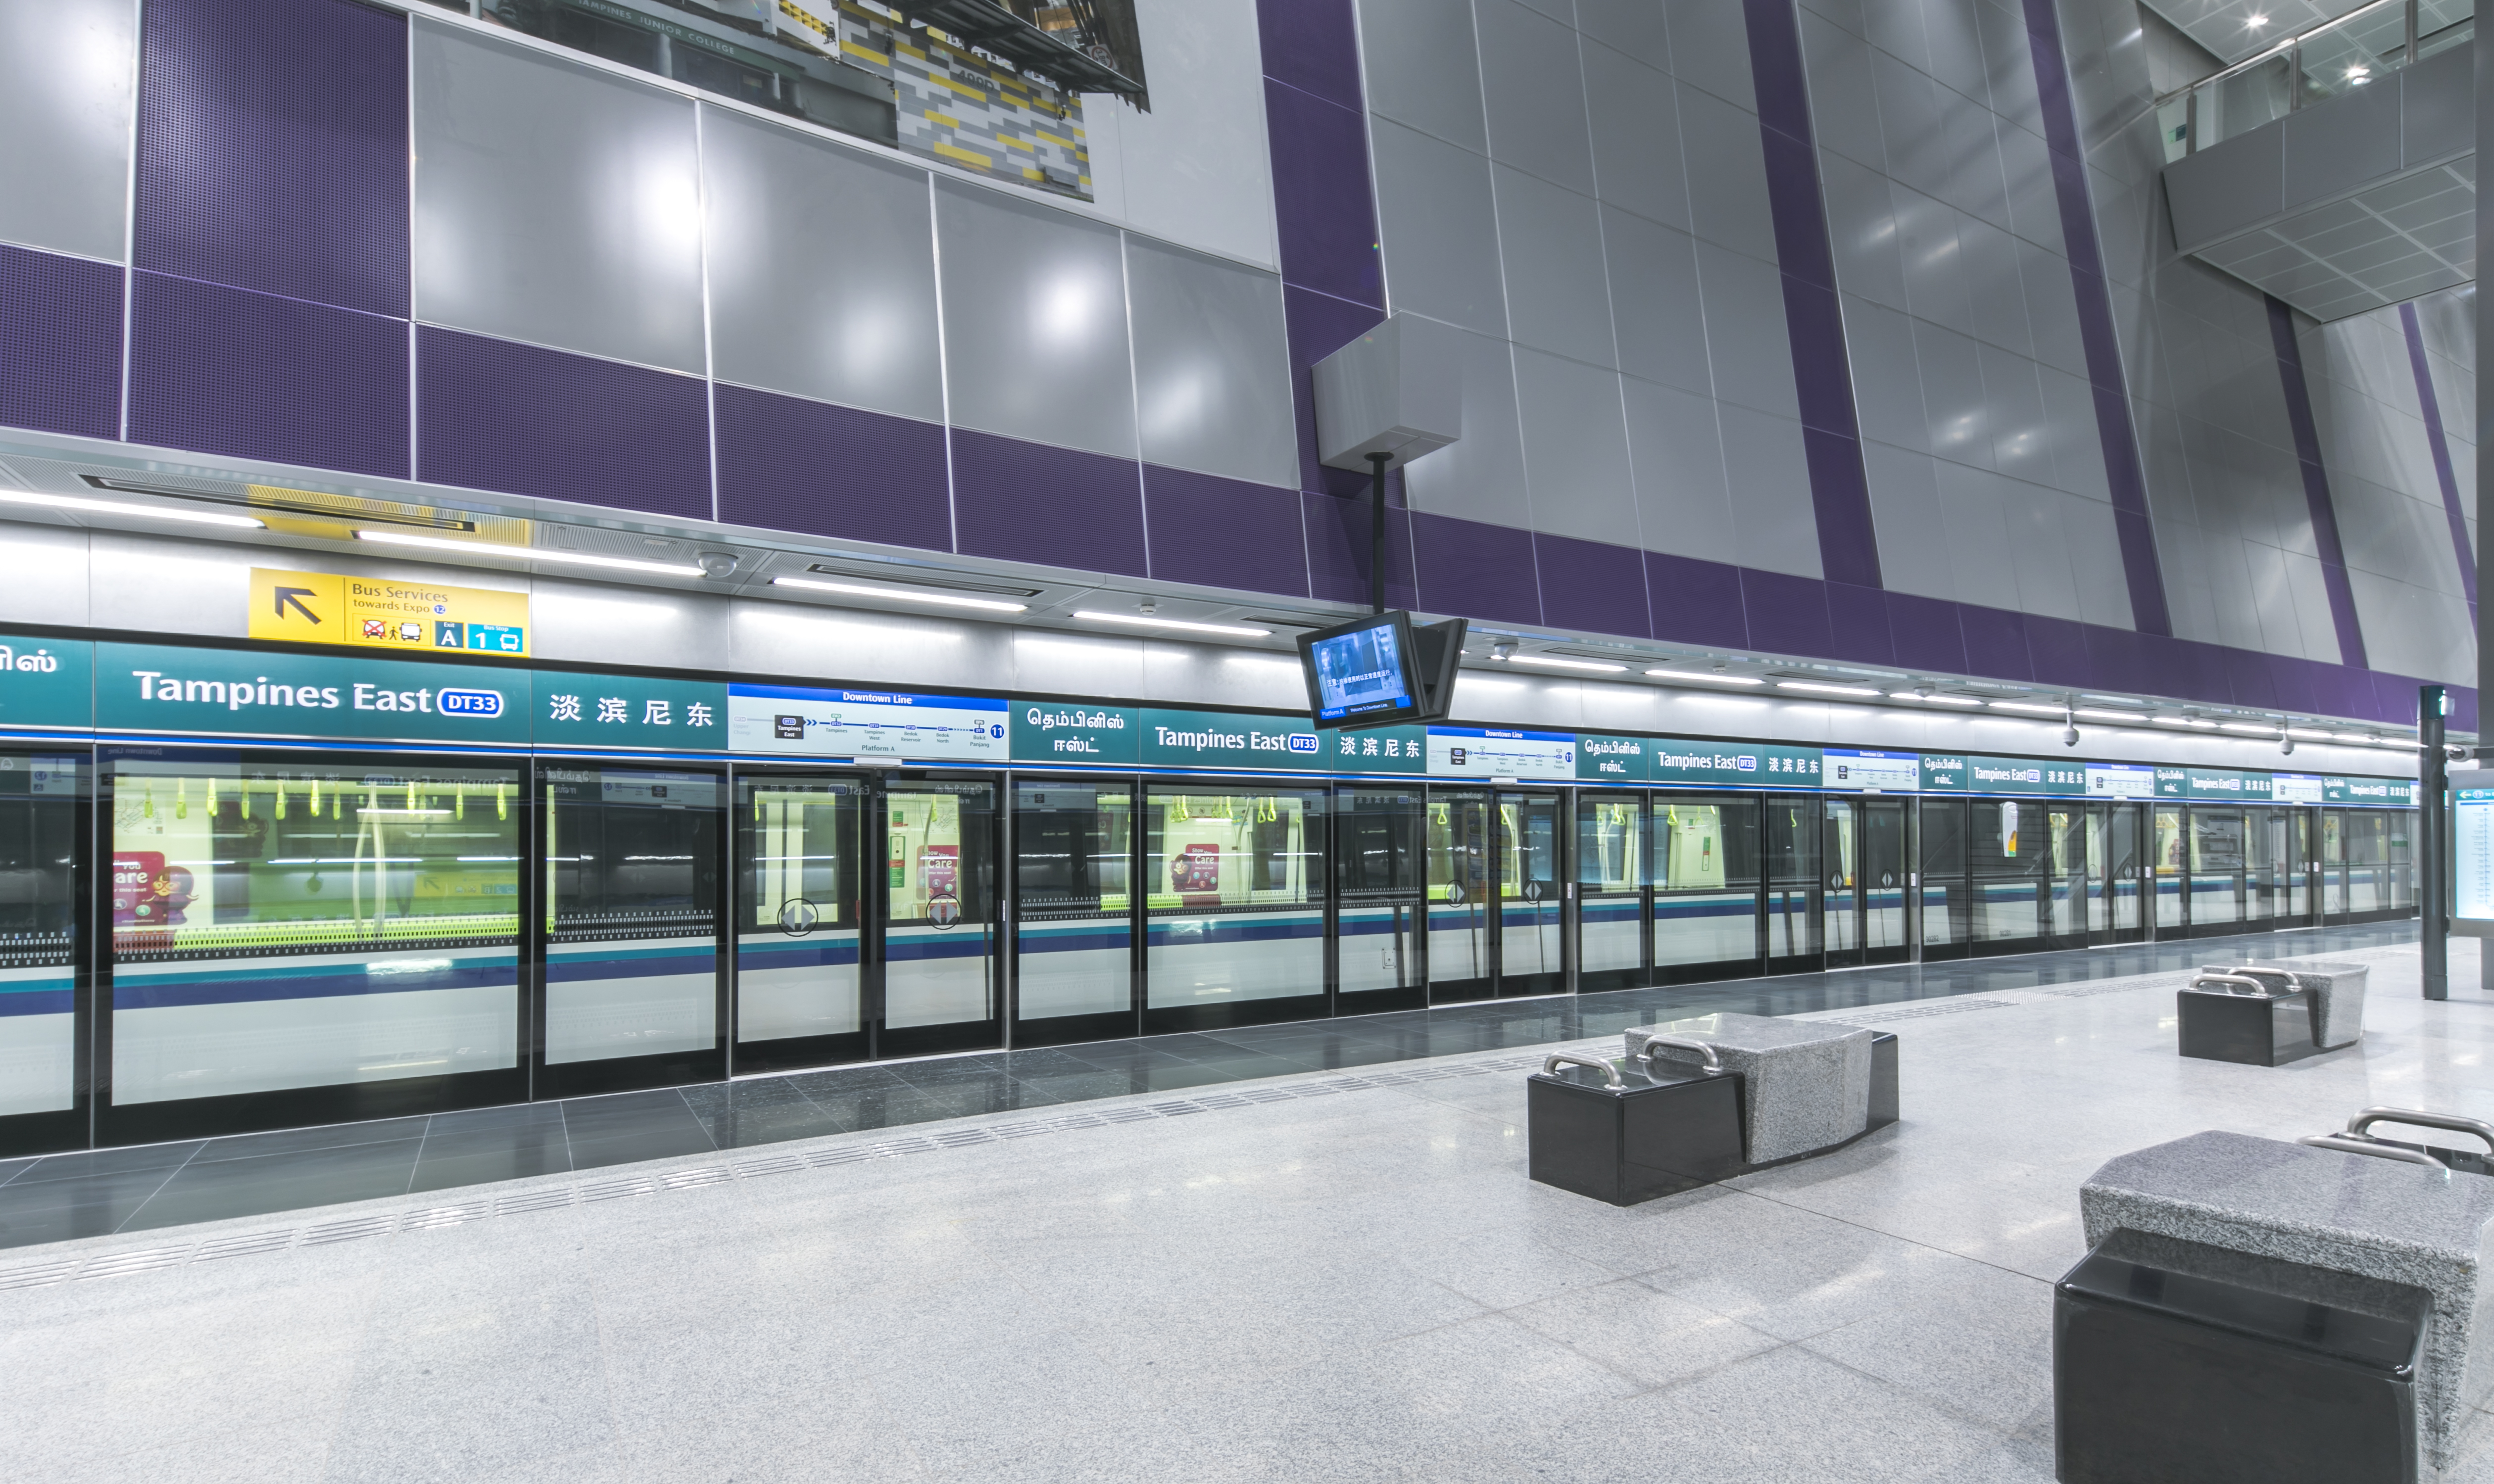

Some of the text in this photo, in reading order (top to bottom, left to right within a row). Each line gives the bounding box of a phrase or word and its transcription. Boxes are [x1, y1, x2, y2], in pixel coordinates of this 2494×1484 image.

[638, 16, 682, 37] JUNIOR
[688, 33, 735, 55] COLLEGE
[957, 70, 994, 92] 499D
[352, 583, 448, 603] Bus Services
[353, 599, 399, 611] towards
[403, 603, 430, 614] Expo
[441, 629, 457, 646] A
[475, 632, 487, 649] 1
[132, 671, 496, 713] Tampines East DT33
[843, 692, 912, 704] Downtown Line
[549, 694, 713, 727] 淡滨尼东
[1027, 708, 1125, 731] தெம்பினிஸ்
[992, 727, 1003, 736] 11
[1155, 726, 1316, 752] Tampines East DT33
[1340, 736, 1420, 758] 淡滨尼东
[1658, 752, 1755, 770] Tampines East DT33
[1768, 757, 1818, 773] 淡滨尼东
[1974, 766, 2010, 782] Tampines
[2011, 768, 2027, 781] East
[2048, 770, 2084, 784] 淡滨尼东
[2191, 777, 2218, 790] Tampines
[2219, 778, 2230, 789] East
[928, 859, 952, 868] Care
[1195, 856, 1214, 864] Care
[115, 872, 148, 884] are
